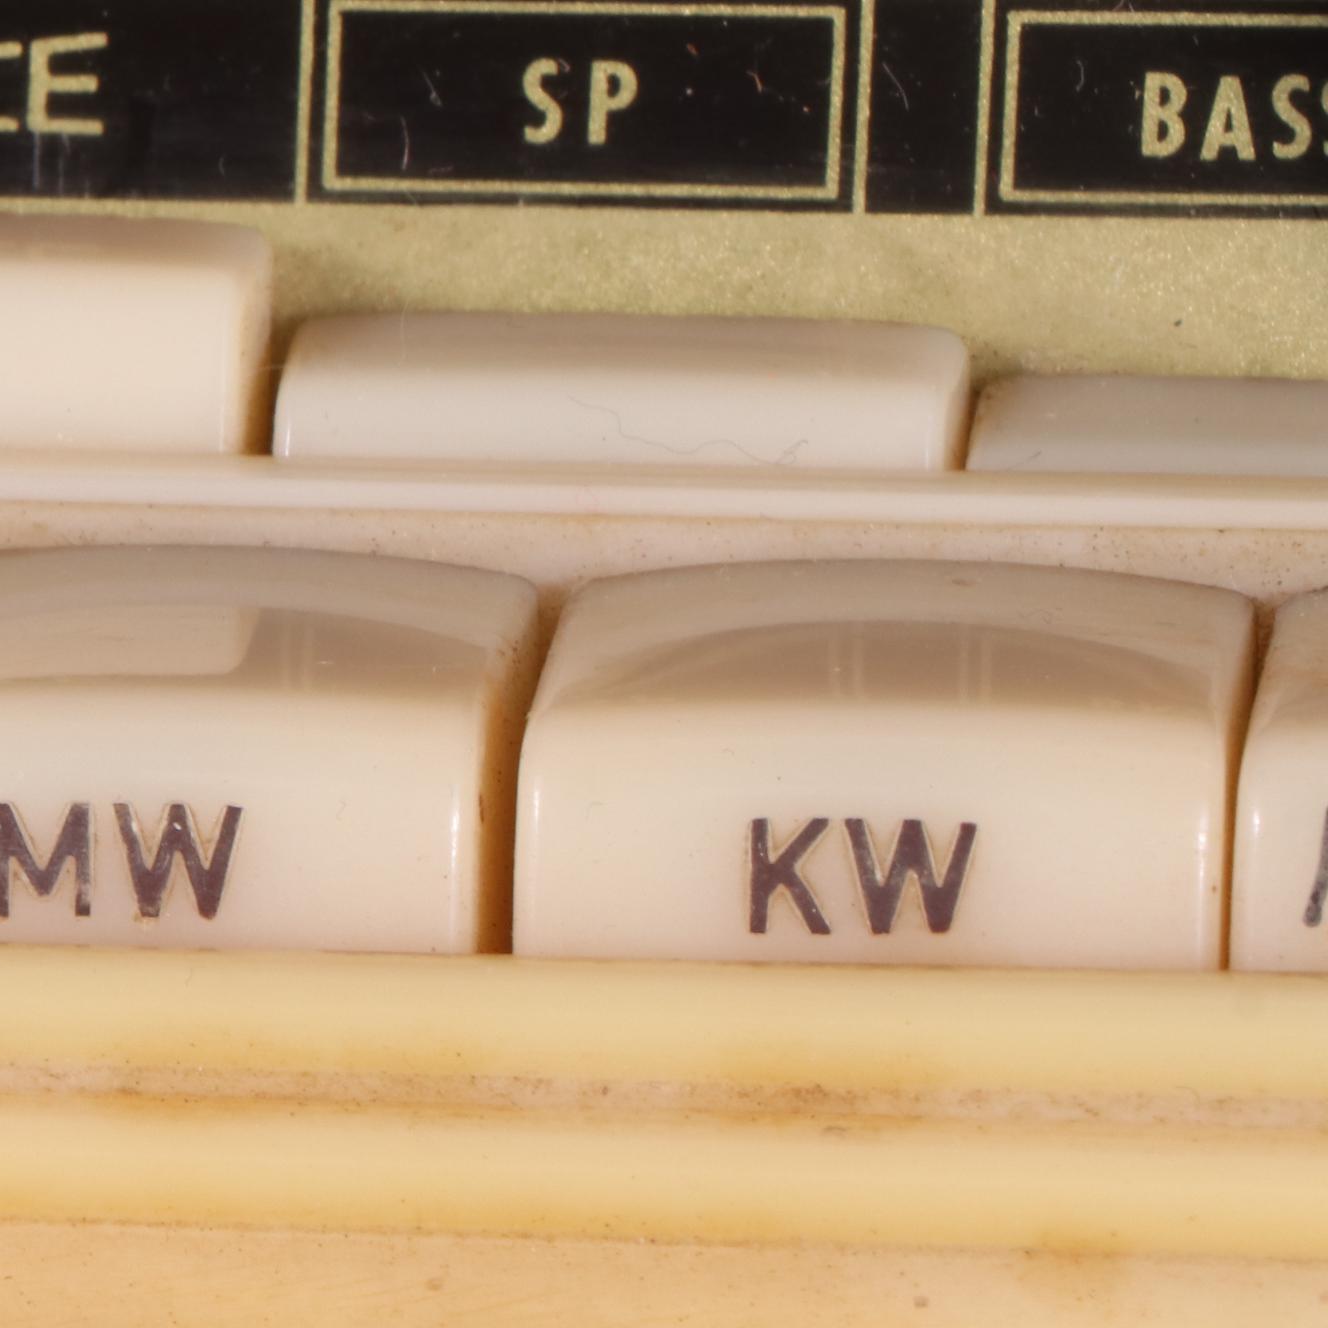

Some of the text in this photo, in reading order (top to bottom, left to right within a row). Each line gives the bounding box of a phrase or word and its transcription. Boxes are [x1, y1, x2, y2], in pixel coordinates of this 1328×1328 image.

[521, 58, 639, 146] SP
[1141, 70, 1328, 162] BAS
[748, 817, 978, 936] KW
